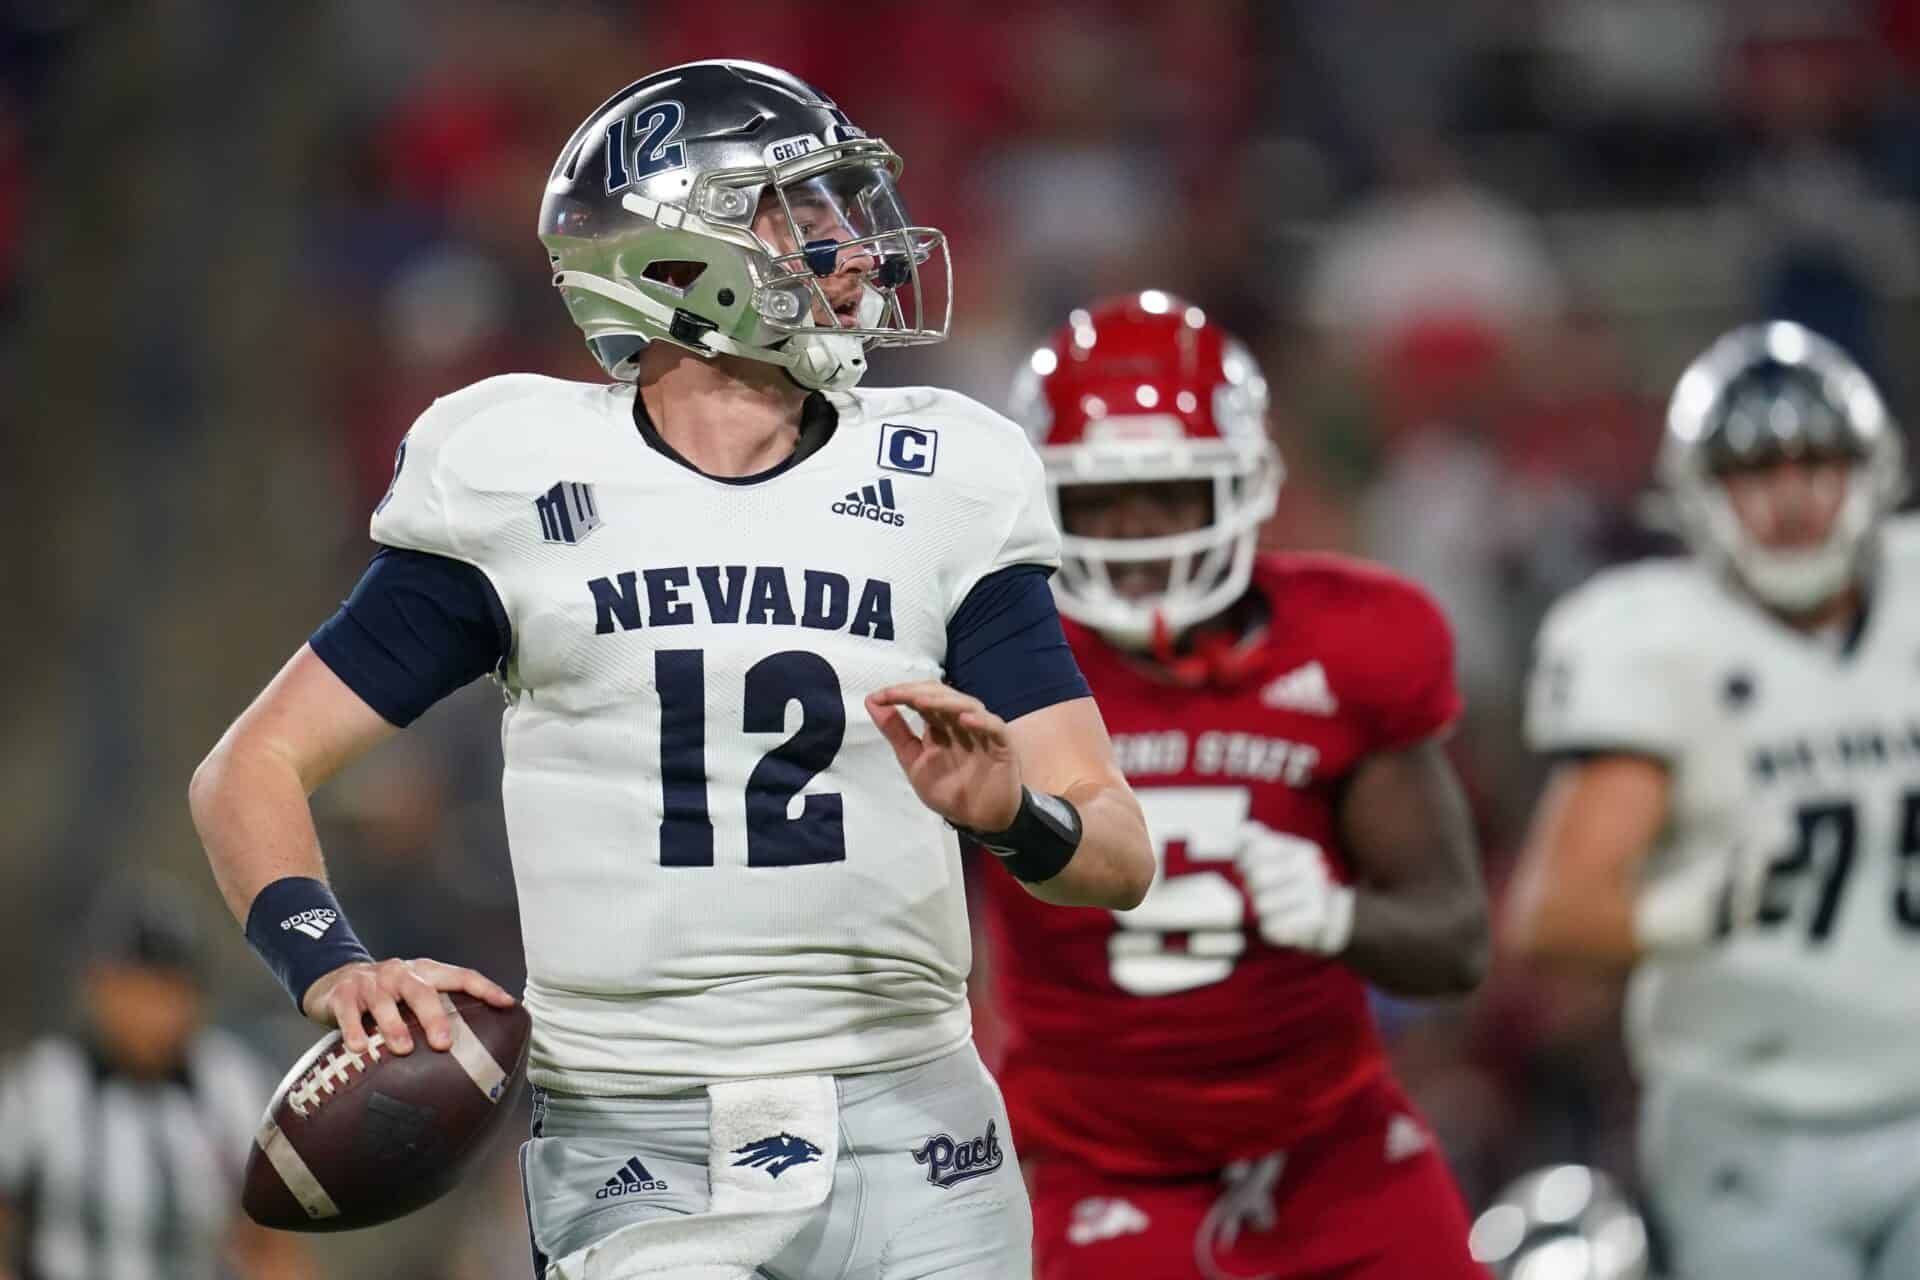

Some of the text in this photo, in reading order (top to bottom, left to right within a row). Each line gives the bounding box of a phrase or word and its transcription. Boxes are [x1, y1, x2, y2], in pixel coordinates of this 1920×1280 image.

[604, 101, 688, 196] 12
[772, 138, 810, 162] GRIT
[889, 429, 927, 469] C
[831, 501, 905, 527] adidas
[587, 565, 895, 641] NEVADA
[654, 648, 847, 868] 12
[280, 908, 337, 931] adidas
[912, 1118, 1003, 1188] Pack
[595, 1180, 668, 1200] adidas
